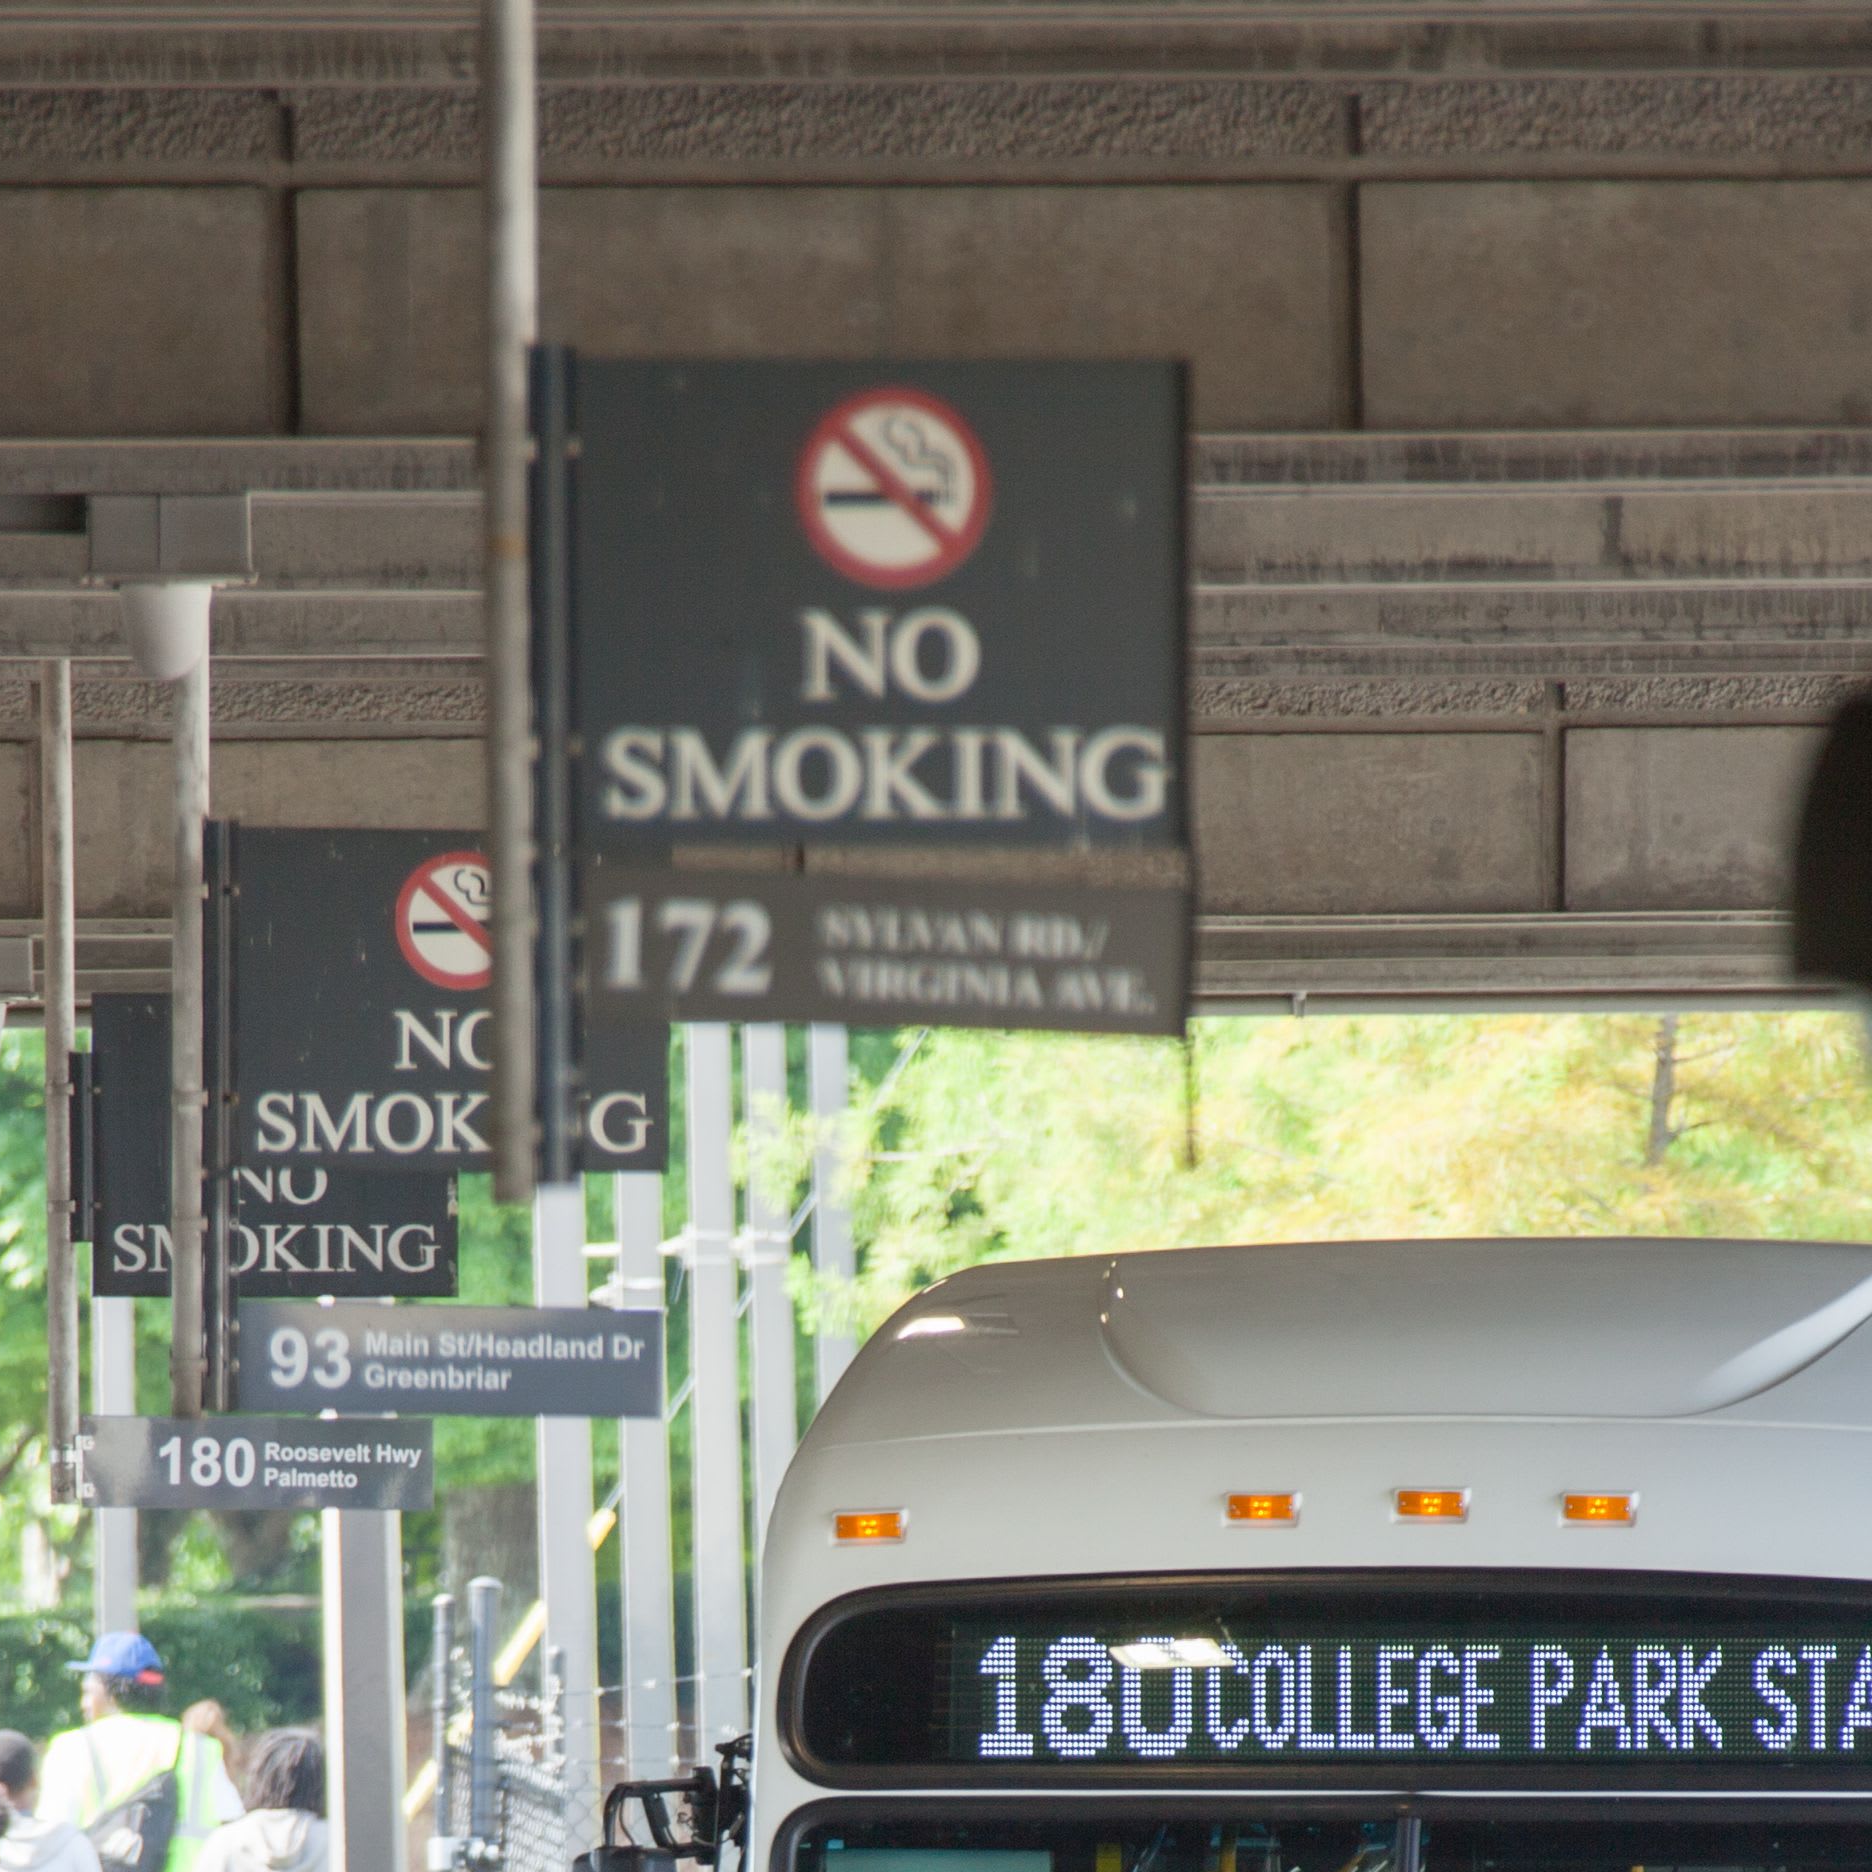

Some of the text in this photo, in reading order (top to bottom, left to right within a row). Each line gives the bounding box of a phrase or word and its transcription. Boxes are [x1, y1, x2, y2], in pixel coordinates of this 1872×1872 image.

[802, 607, 981, 702] NO
[603, 725, 1173, 821] SMOKING
[606, 897, 773, 995] 172
[256, 1091, 654, 1155] SMOKG
[270, 1327, 352, 1389] 93
[364, 1362, 513, 1391] Greenbriar
[365, 1332, 646, 1361] Main St/Headland Dr
[158, 1436, 257, 1488] 180
[263, 1442, 422, 1468] Roosevelt Hwy
[263, 1467, 359, 1489] Palmetto
[978, 1636, 1194, 1757] 180
[1206, 1644, 1501, 1750] COLLEGE
[1532, 1644, 1724, 1750] PARK
